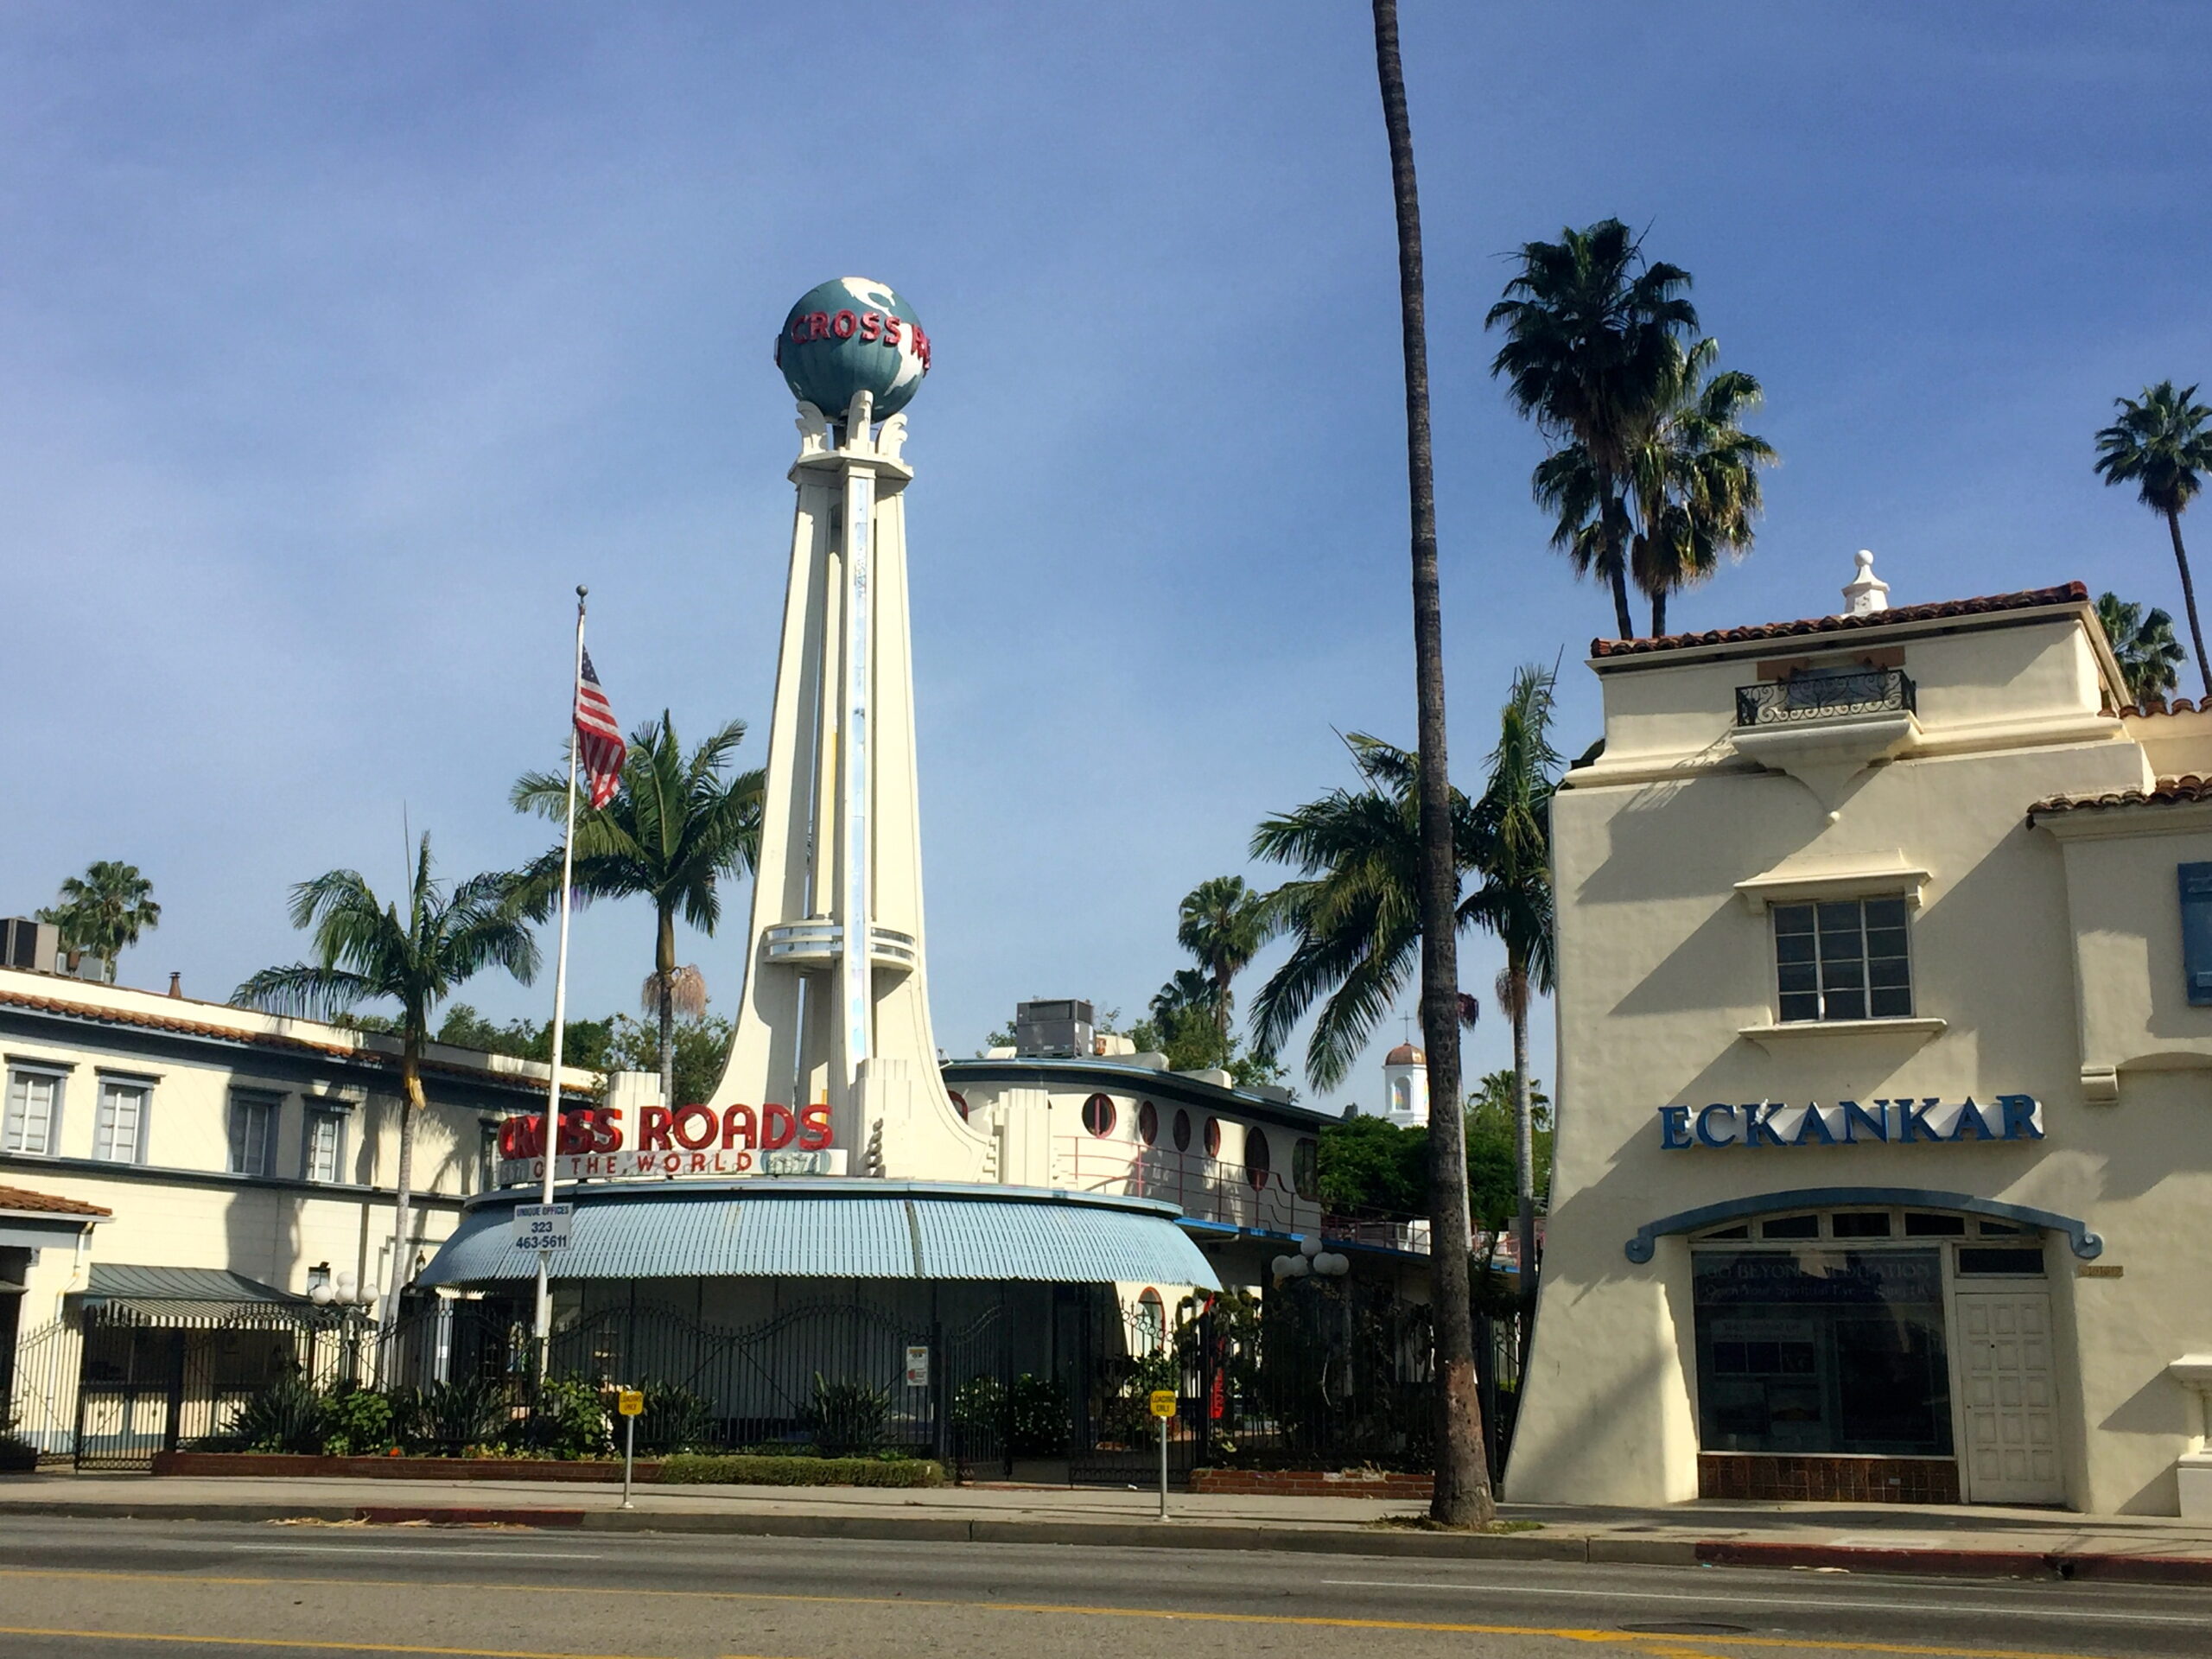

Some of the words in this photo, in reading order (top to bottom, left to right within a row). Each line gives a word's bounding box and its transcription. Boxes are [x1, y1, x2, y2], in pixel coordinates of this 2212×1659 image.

[791, 309, 901, 346] CROSS
[639, 1103, 834, 1151] ROADS
[1658, 1094, 2046, 1150] ECKANKAR
[570, 1155, 617, 1176] THE
[637, 1152, 753, 1173] WORLD
[542, 1205, 569, 1216] OFFICES
[531, 1221, 553, 1233] 323
[516, 1235, 568, 1249] 463-5611
[1705, 1264, 1732, 1279] GO
[1737, 1263, 1808, 1280] BEYON
